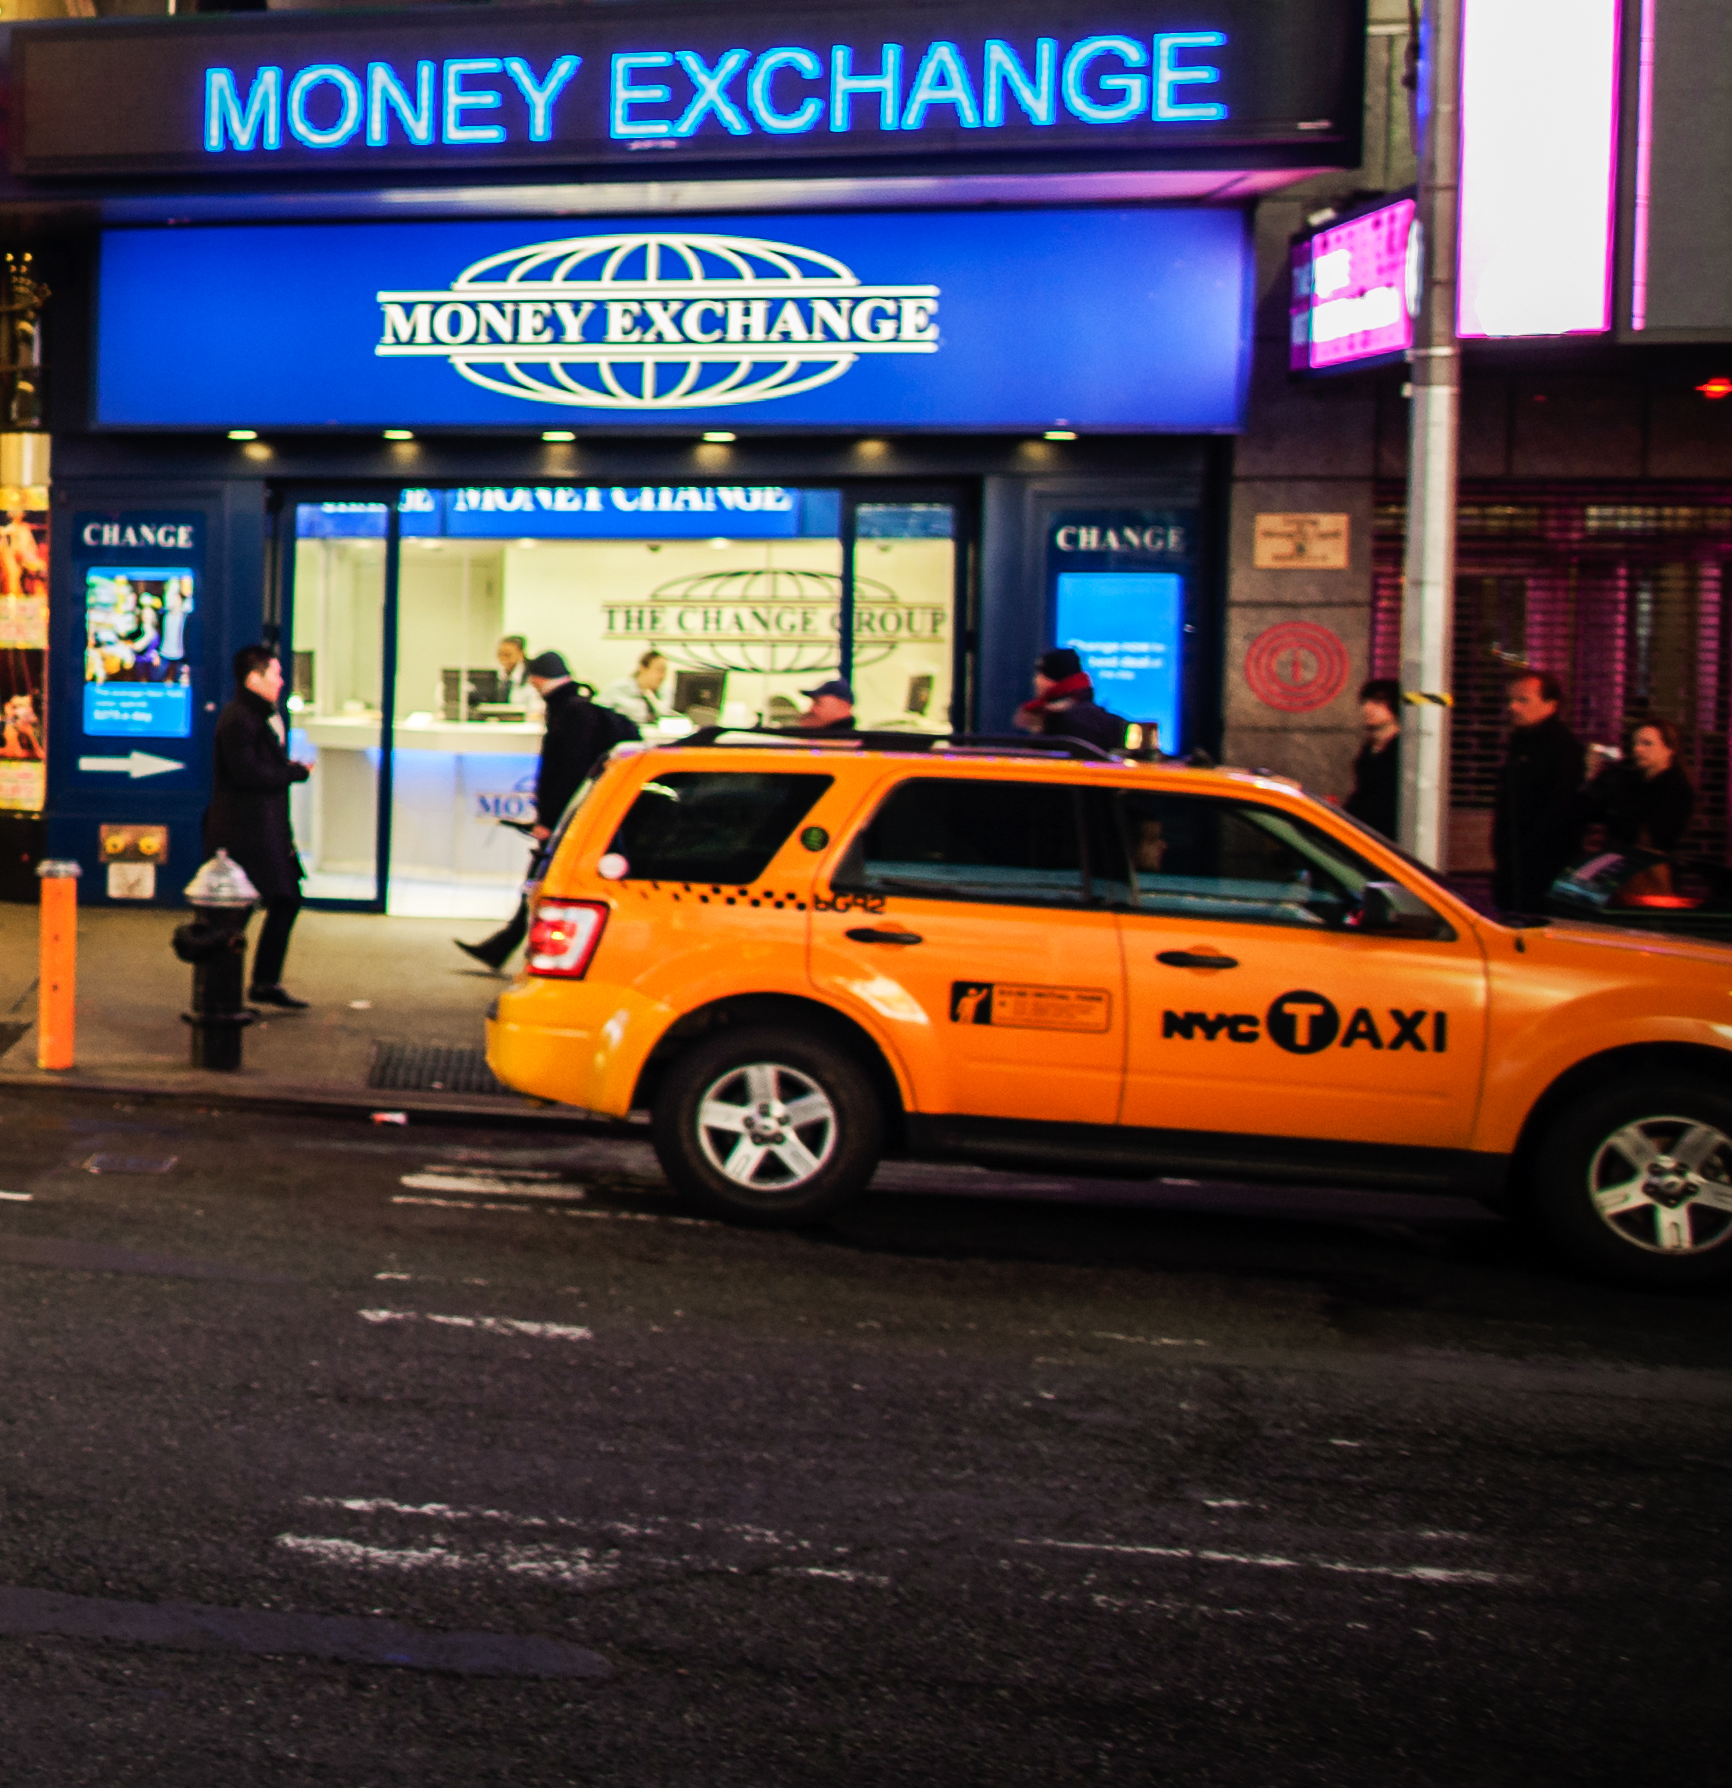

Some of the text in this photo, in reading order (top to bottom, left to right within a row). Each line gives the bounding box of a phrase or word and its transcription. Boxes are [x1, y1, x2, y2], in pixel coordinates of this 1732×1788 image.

[203, 31, 1227, 152] MONEY EXCHANGE
[379, 296, 940, 345] MONEY EXCHANGE
[83, 522, 195, 549] CHANGE
[1055, 524, 1186, 553] CHANGE
[603, 604, 816, 635] THE CHANGE
[1160, 989, 1447, 1055] NYC TAXI
